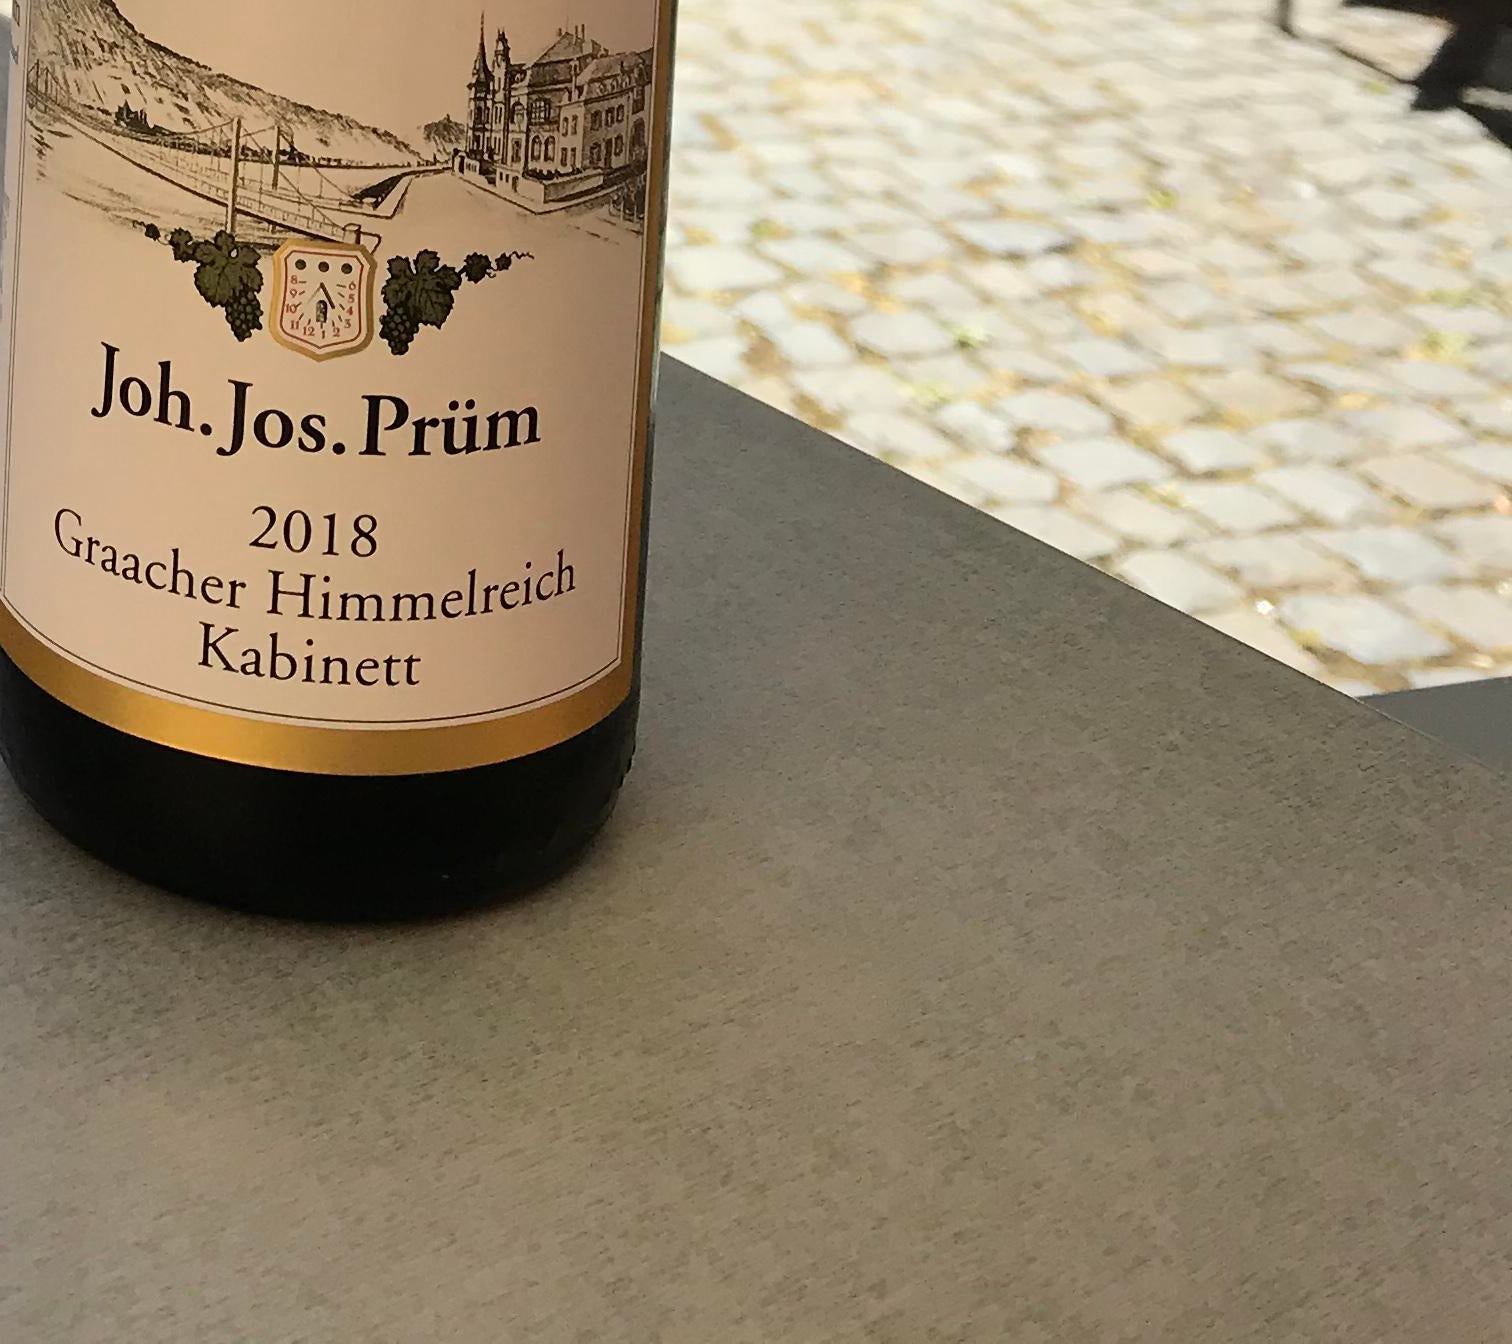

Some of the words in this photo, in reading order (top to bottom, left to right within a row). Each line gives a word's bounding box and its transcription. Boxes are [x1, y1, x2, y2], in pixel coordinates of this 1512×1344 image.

[290, 275, 298, 284] 8
[349, 281, 356, 291] 6
[289, 288, 297, 298] 9
[348, 294, 355, 304] 5
[285, 303, 297, 313] 10
[346, 306, 353, 315] 4
[290, 320, 300, 330] 11
[344, 319, 351, 328] 3
[303, 326, 315, 337] 12
[333, 327, 340, 337] 2
[90, 341, 213, 436] Joh.
[216, 378, 346, 457] Jos.
[358, 394, 541, 457] Prüm
[249, 504, 378, 558] 2018
[54, 508, 247, 609] Graacher
[266, 548, 576, 622] Himmelreich
[198, 621, 422, 687] Kabinett
